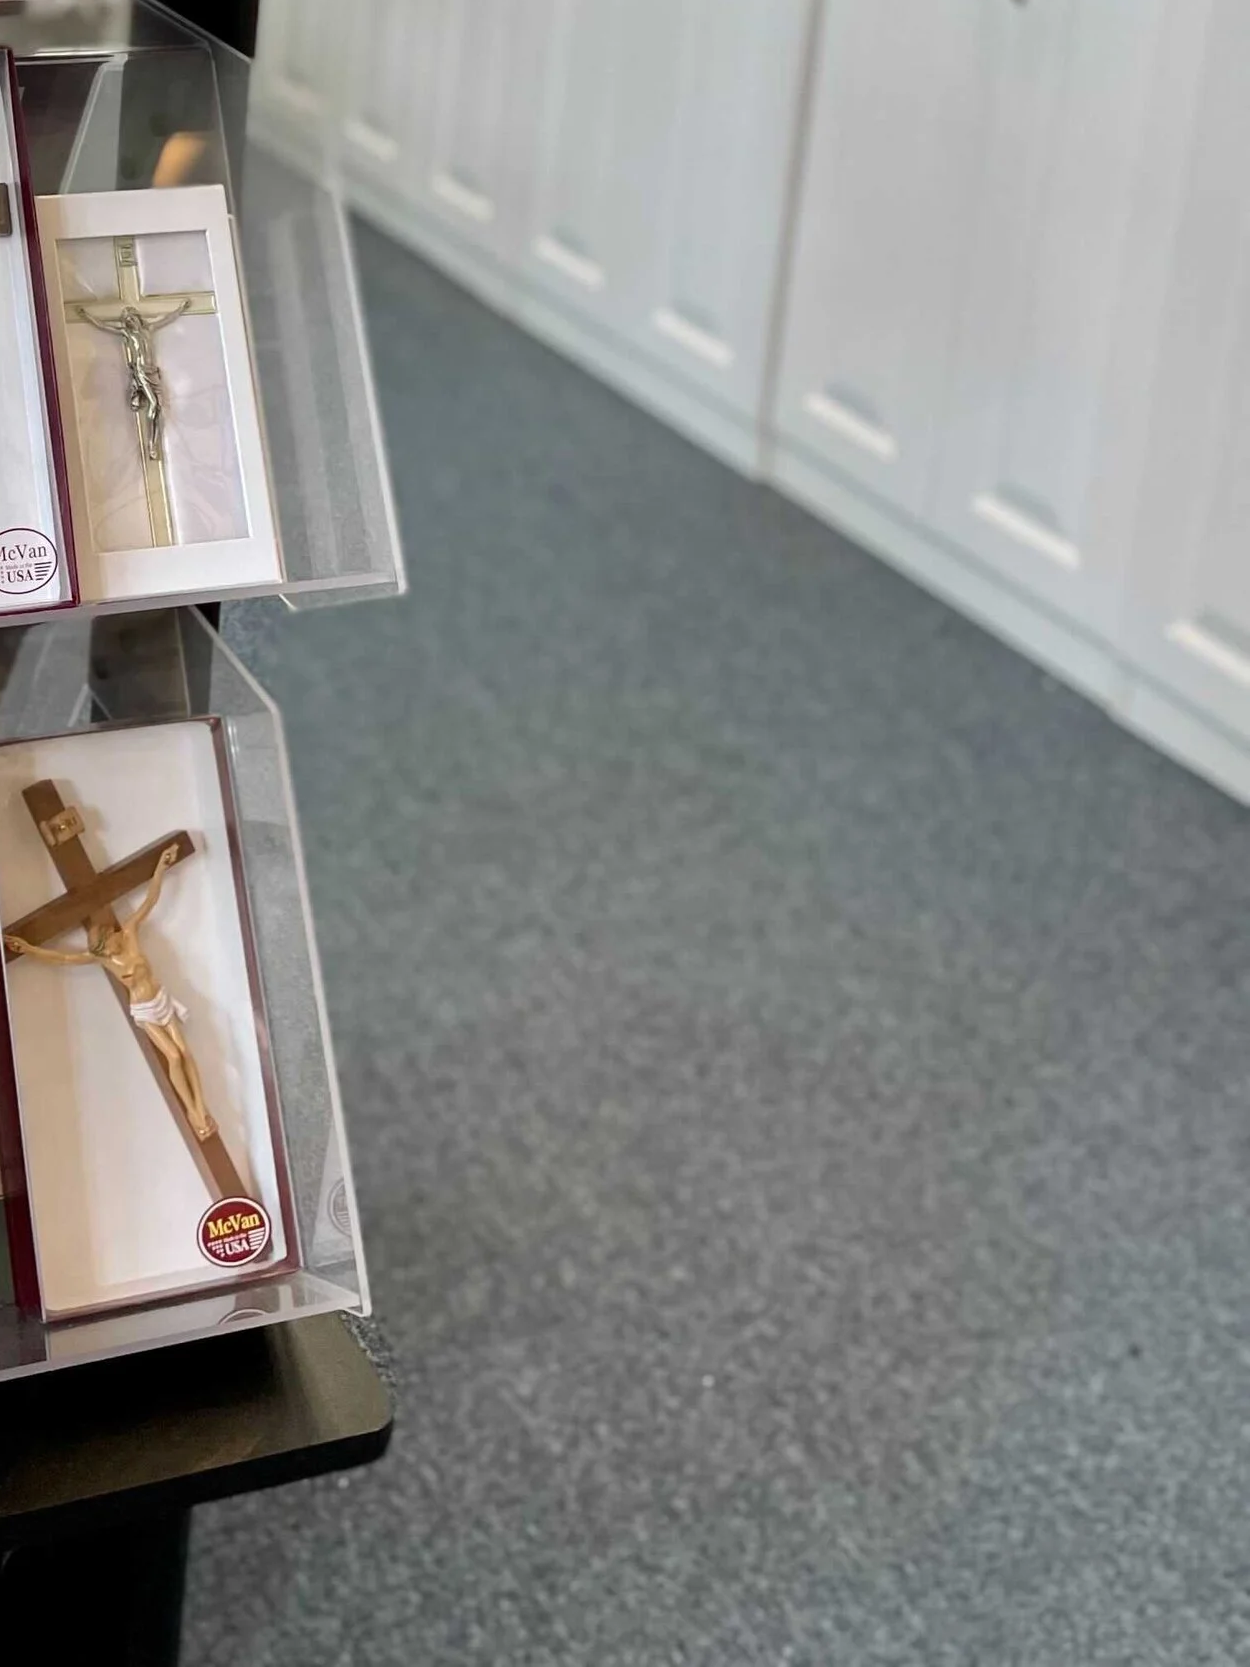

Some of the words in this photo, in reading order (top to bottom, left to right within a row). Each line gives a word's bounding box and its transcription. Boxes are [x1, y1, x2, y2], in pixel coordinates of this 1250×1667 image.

[6, 569, 34, 583] USA
[207, 1214, 261, 1239] McVan
[225, 1238, 250, 1255] USA
